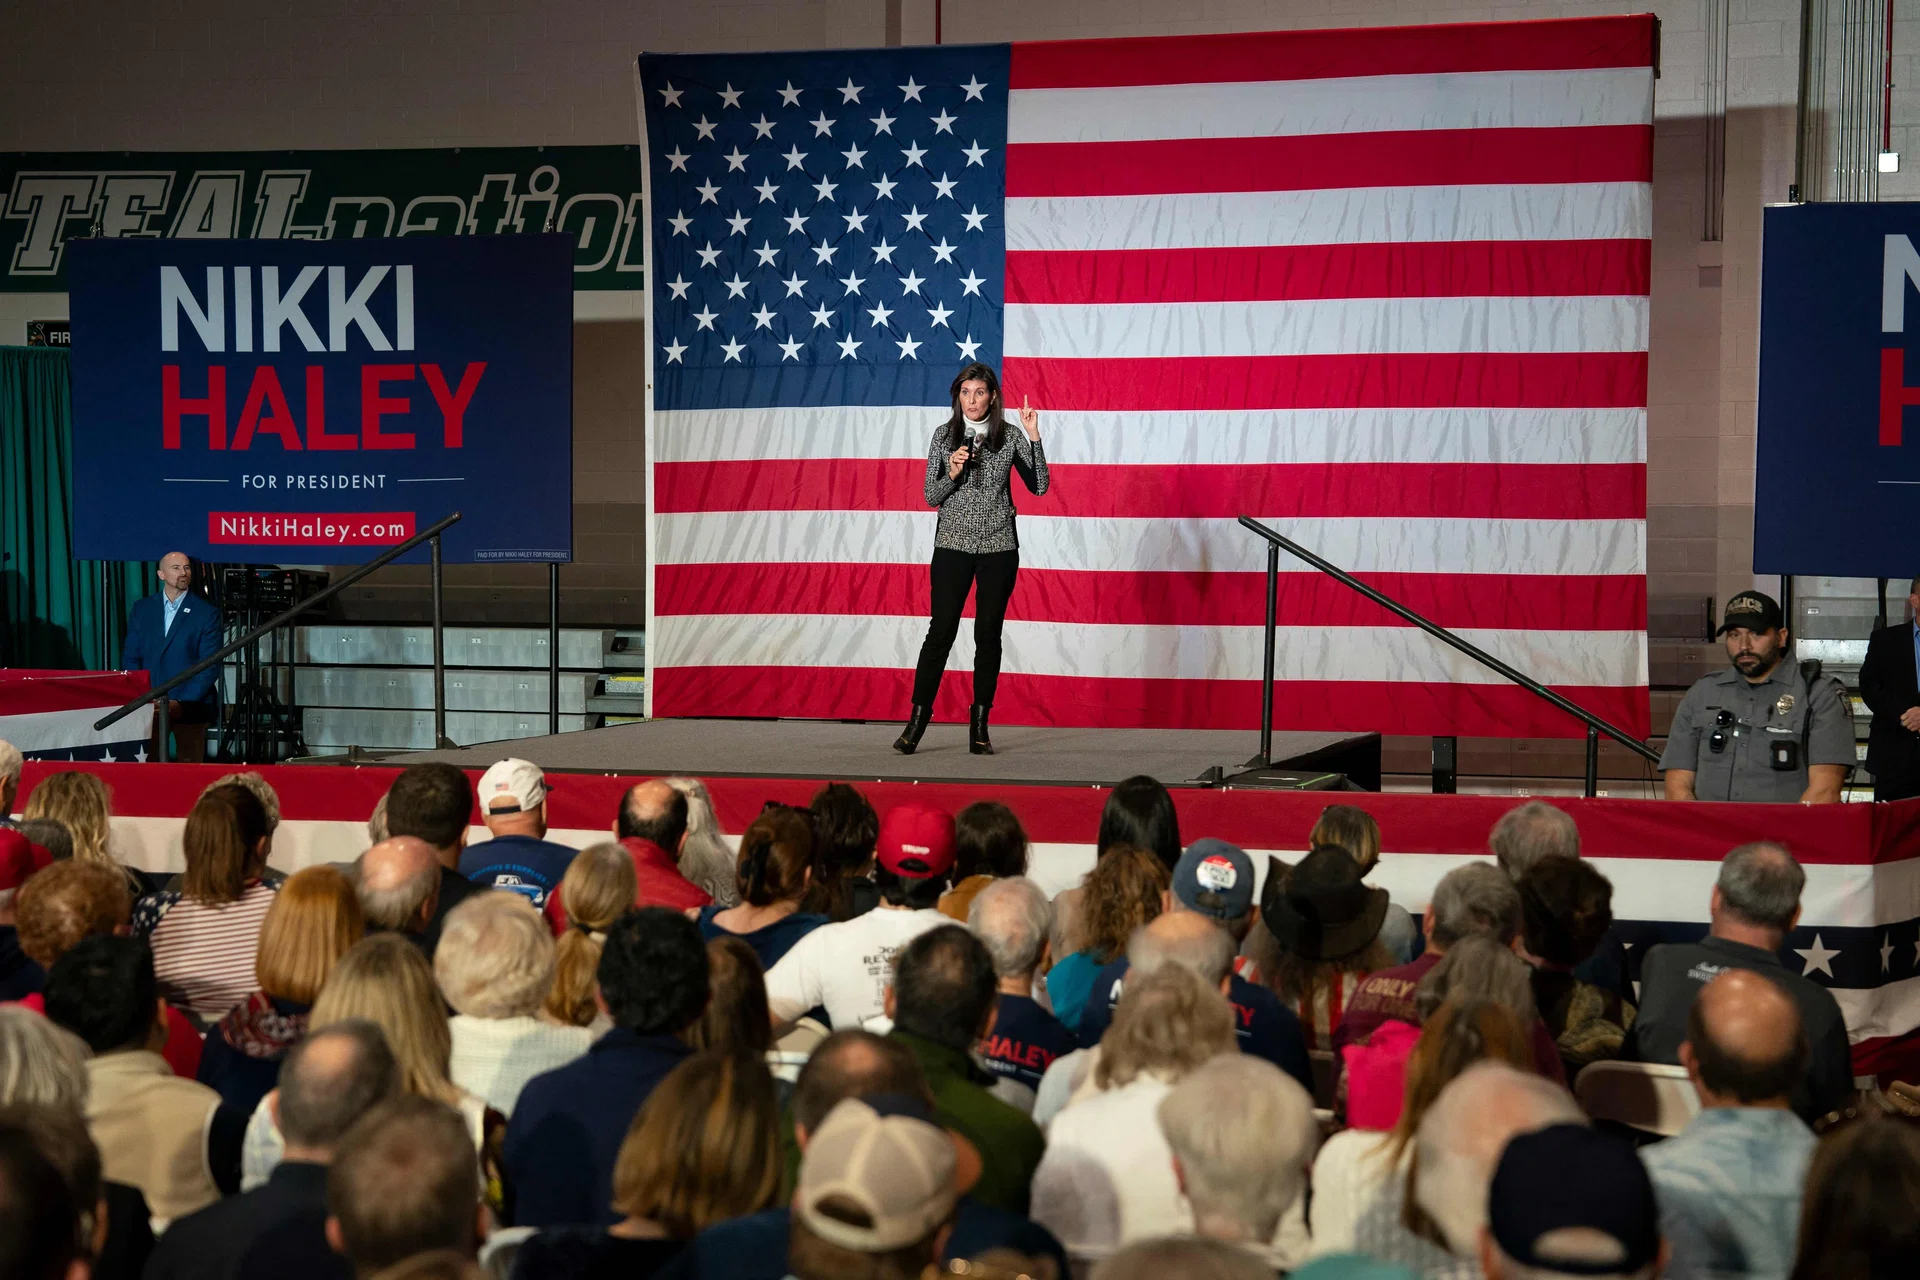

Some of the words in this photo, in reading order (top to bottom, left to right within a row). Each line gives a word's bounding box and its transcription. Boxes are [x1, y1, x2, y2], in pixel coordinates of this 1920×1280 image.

[160, 265, 415, 352] NIKKI
[161, 361, 489, 451] HALEY
[242, 474, 278, 489] FOR
[286, 474, 386, 489] PRESIDENT
[221, 516, 405, 543] NikkiHaley.com
